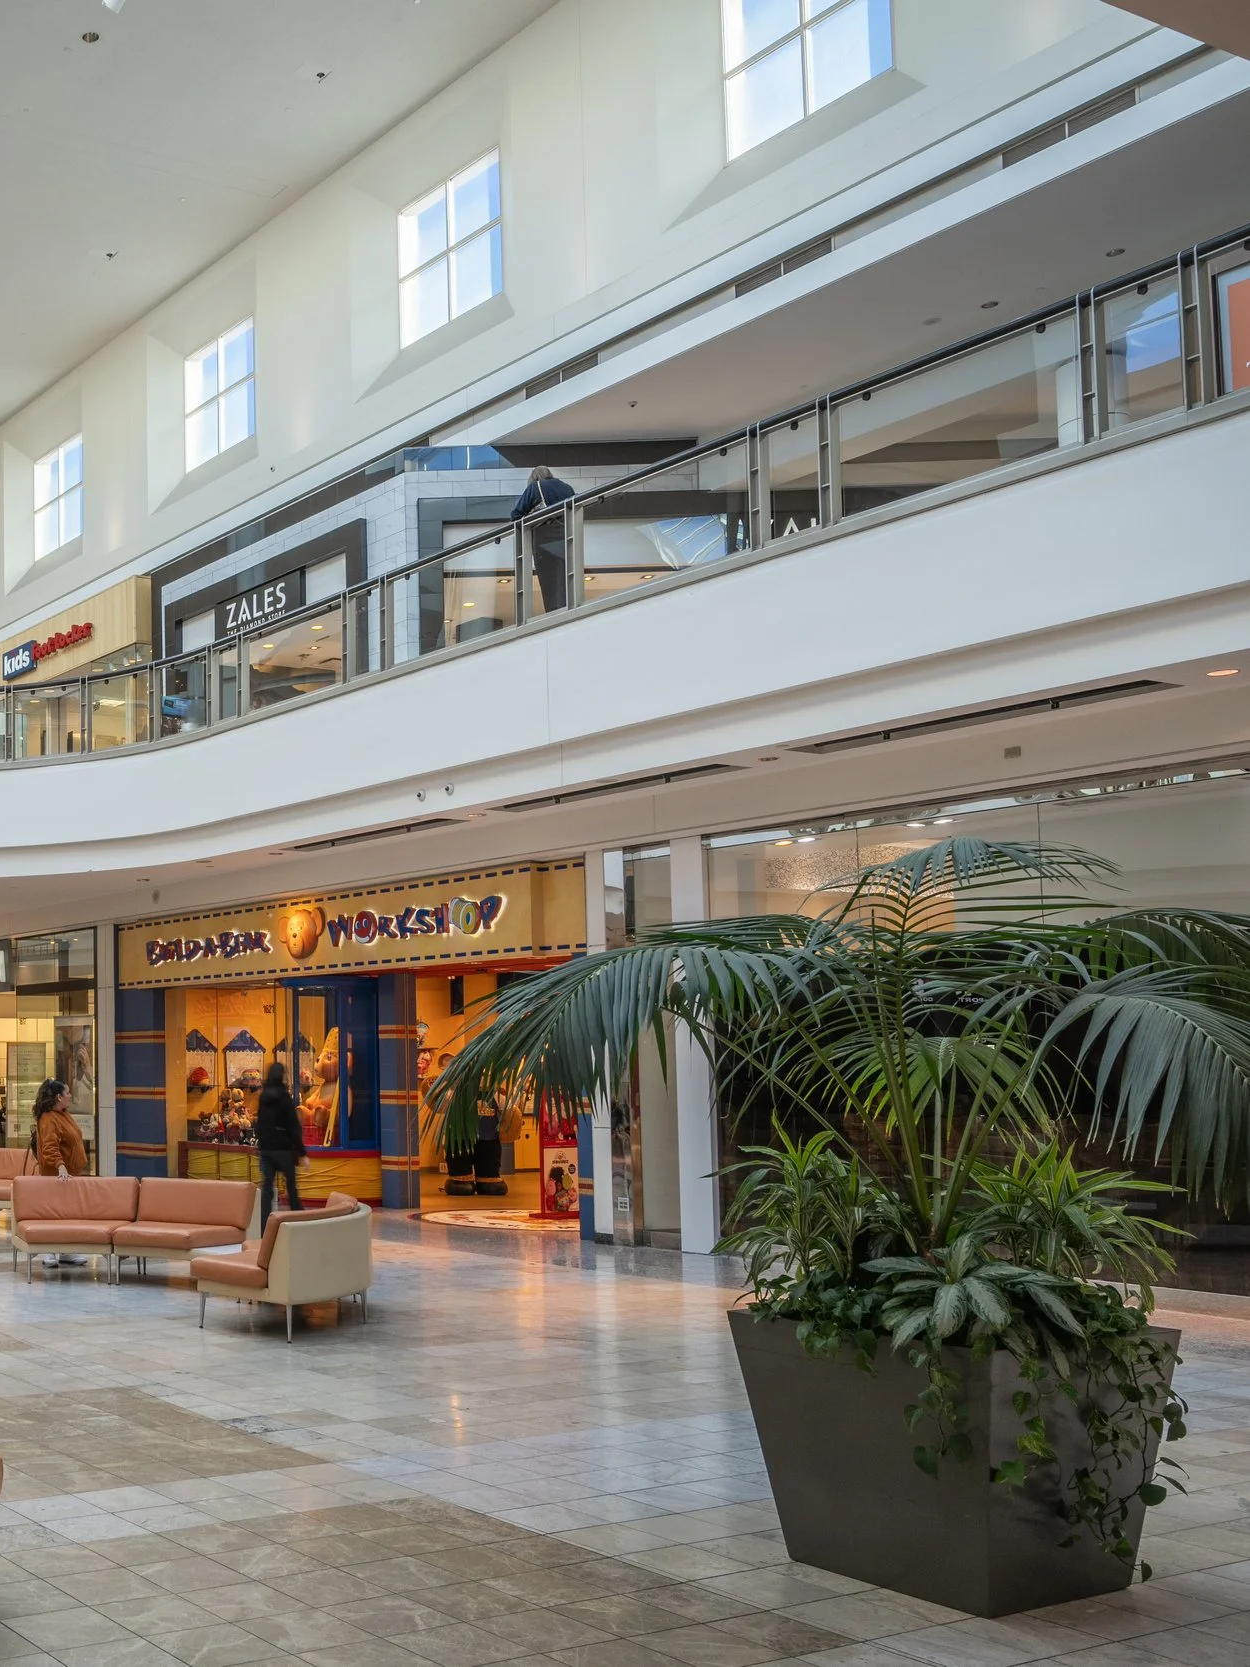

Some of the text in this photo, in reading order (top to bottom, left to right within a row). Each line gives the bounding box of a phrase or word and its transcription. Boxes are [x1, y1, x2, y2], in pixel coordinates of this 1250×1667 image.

[226, 582, 286, 629] ZALES
[240, 617, 266, 632] DIAMOND
[3, 648, 30, 676] kids
[146, 895, 504, 967] BUILD-A-BEAR WORKSHOP
